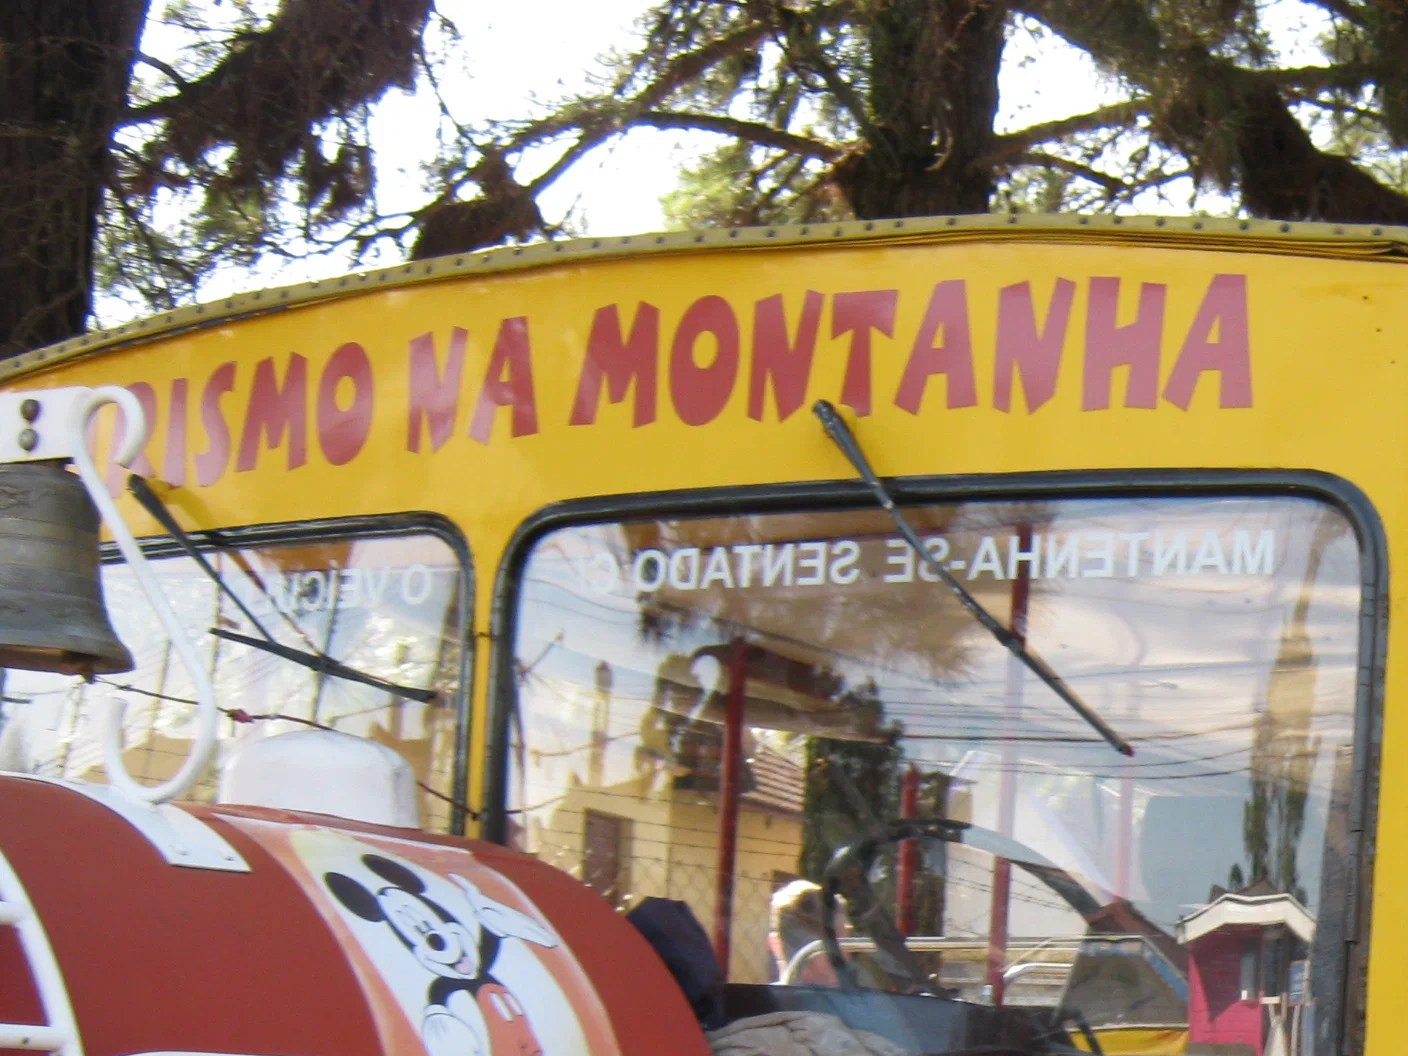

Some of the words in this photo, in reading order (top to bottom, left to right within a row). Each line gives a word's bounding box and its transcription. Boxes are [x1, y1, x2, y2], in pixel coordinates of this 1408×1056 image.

[84, 342, 374, 500] RISMO
[407, 315, 539, 454] NA
[568, 273, 1253, 428] MONTANHA
